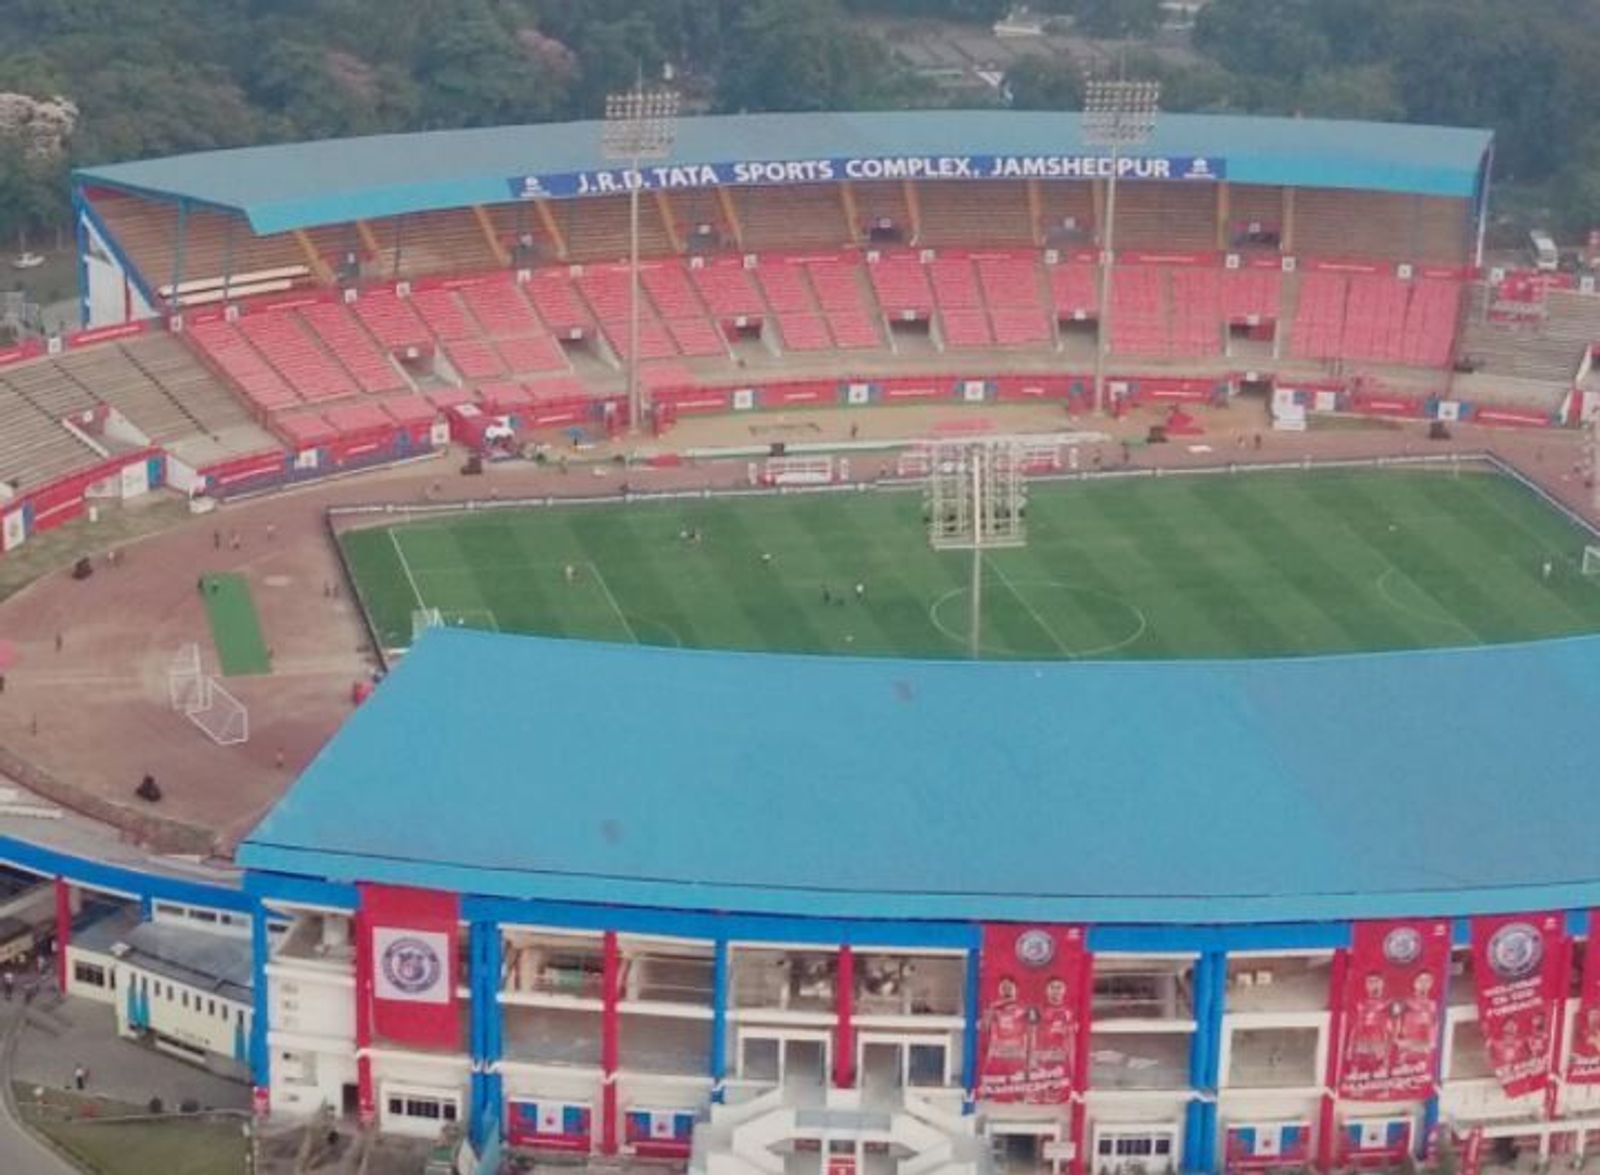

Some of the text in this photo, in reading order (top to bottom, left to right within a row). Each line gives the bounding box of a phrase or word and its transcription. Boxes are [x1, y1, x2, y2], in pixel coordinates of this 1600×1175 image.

[577, 170, 651, 193] J.R.D.
[653, 164, 720, 187] TATA
[733, 159, 834, 182] SPORTS
[990, 157, 1171, 177] JAMSHEDPUR
